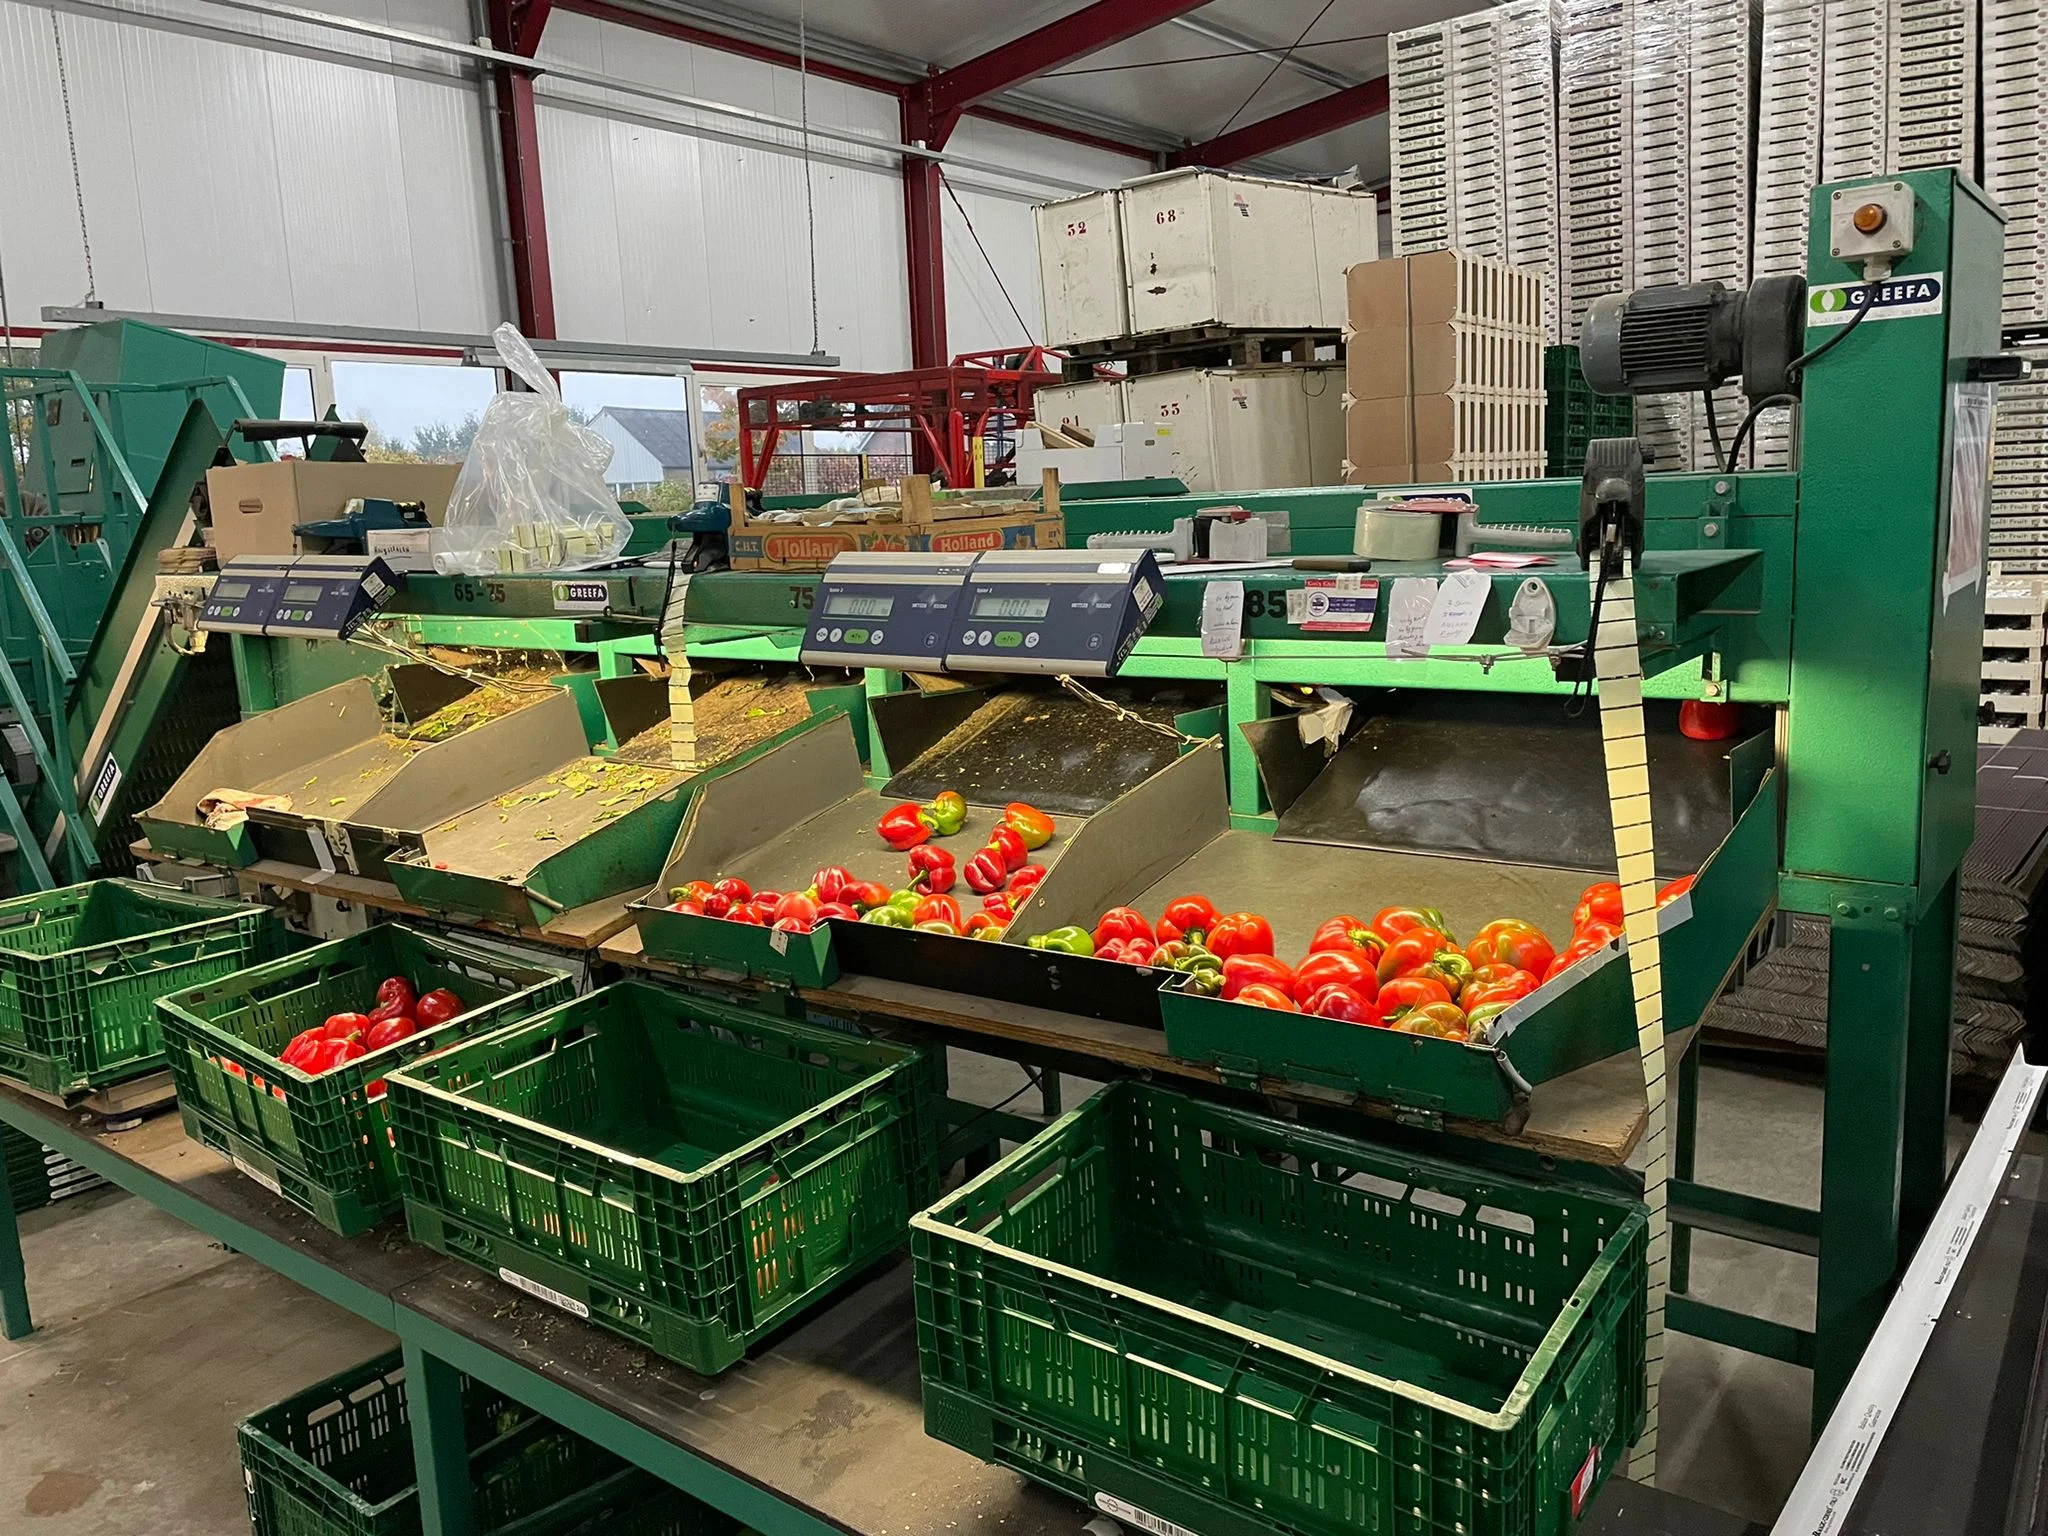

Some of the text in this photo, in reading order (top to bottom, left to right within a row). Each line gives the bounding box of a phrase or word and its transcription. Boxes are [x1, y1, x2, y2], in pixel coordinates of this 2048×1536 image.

[1156, 209, 1176, 225] 68
[1850, 283, 1931, 305] GEEFA
[776, 538, 844, 558] Holland
[940, 534, 995, 552] Holland
[570, 586, 604, 598] GREEFA
[789, 586, 814, 610] 75
[1246, 590, 1288, 619] 85
